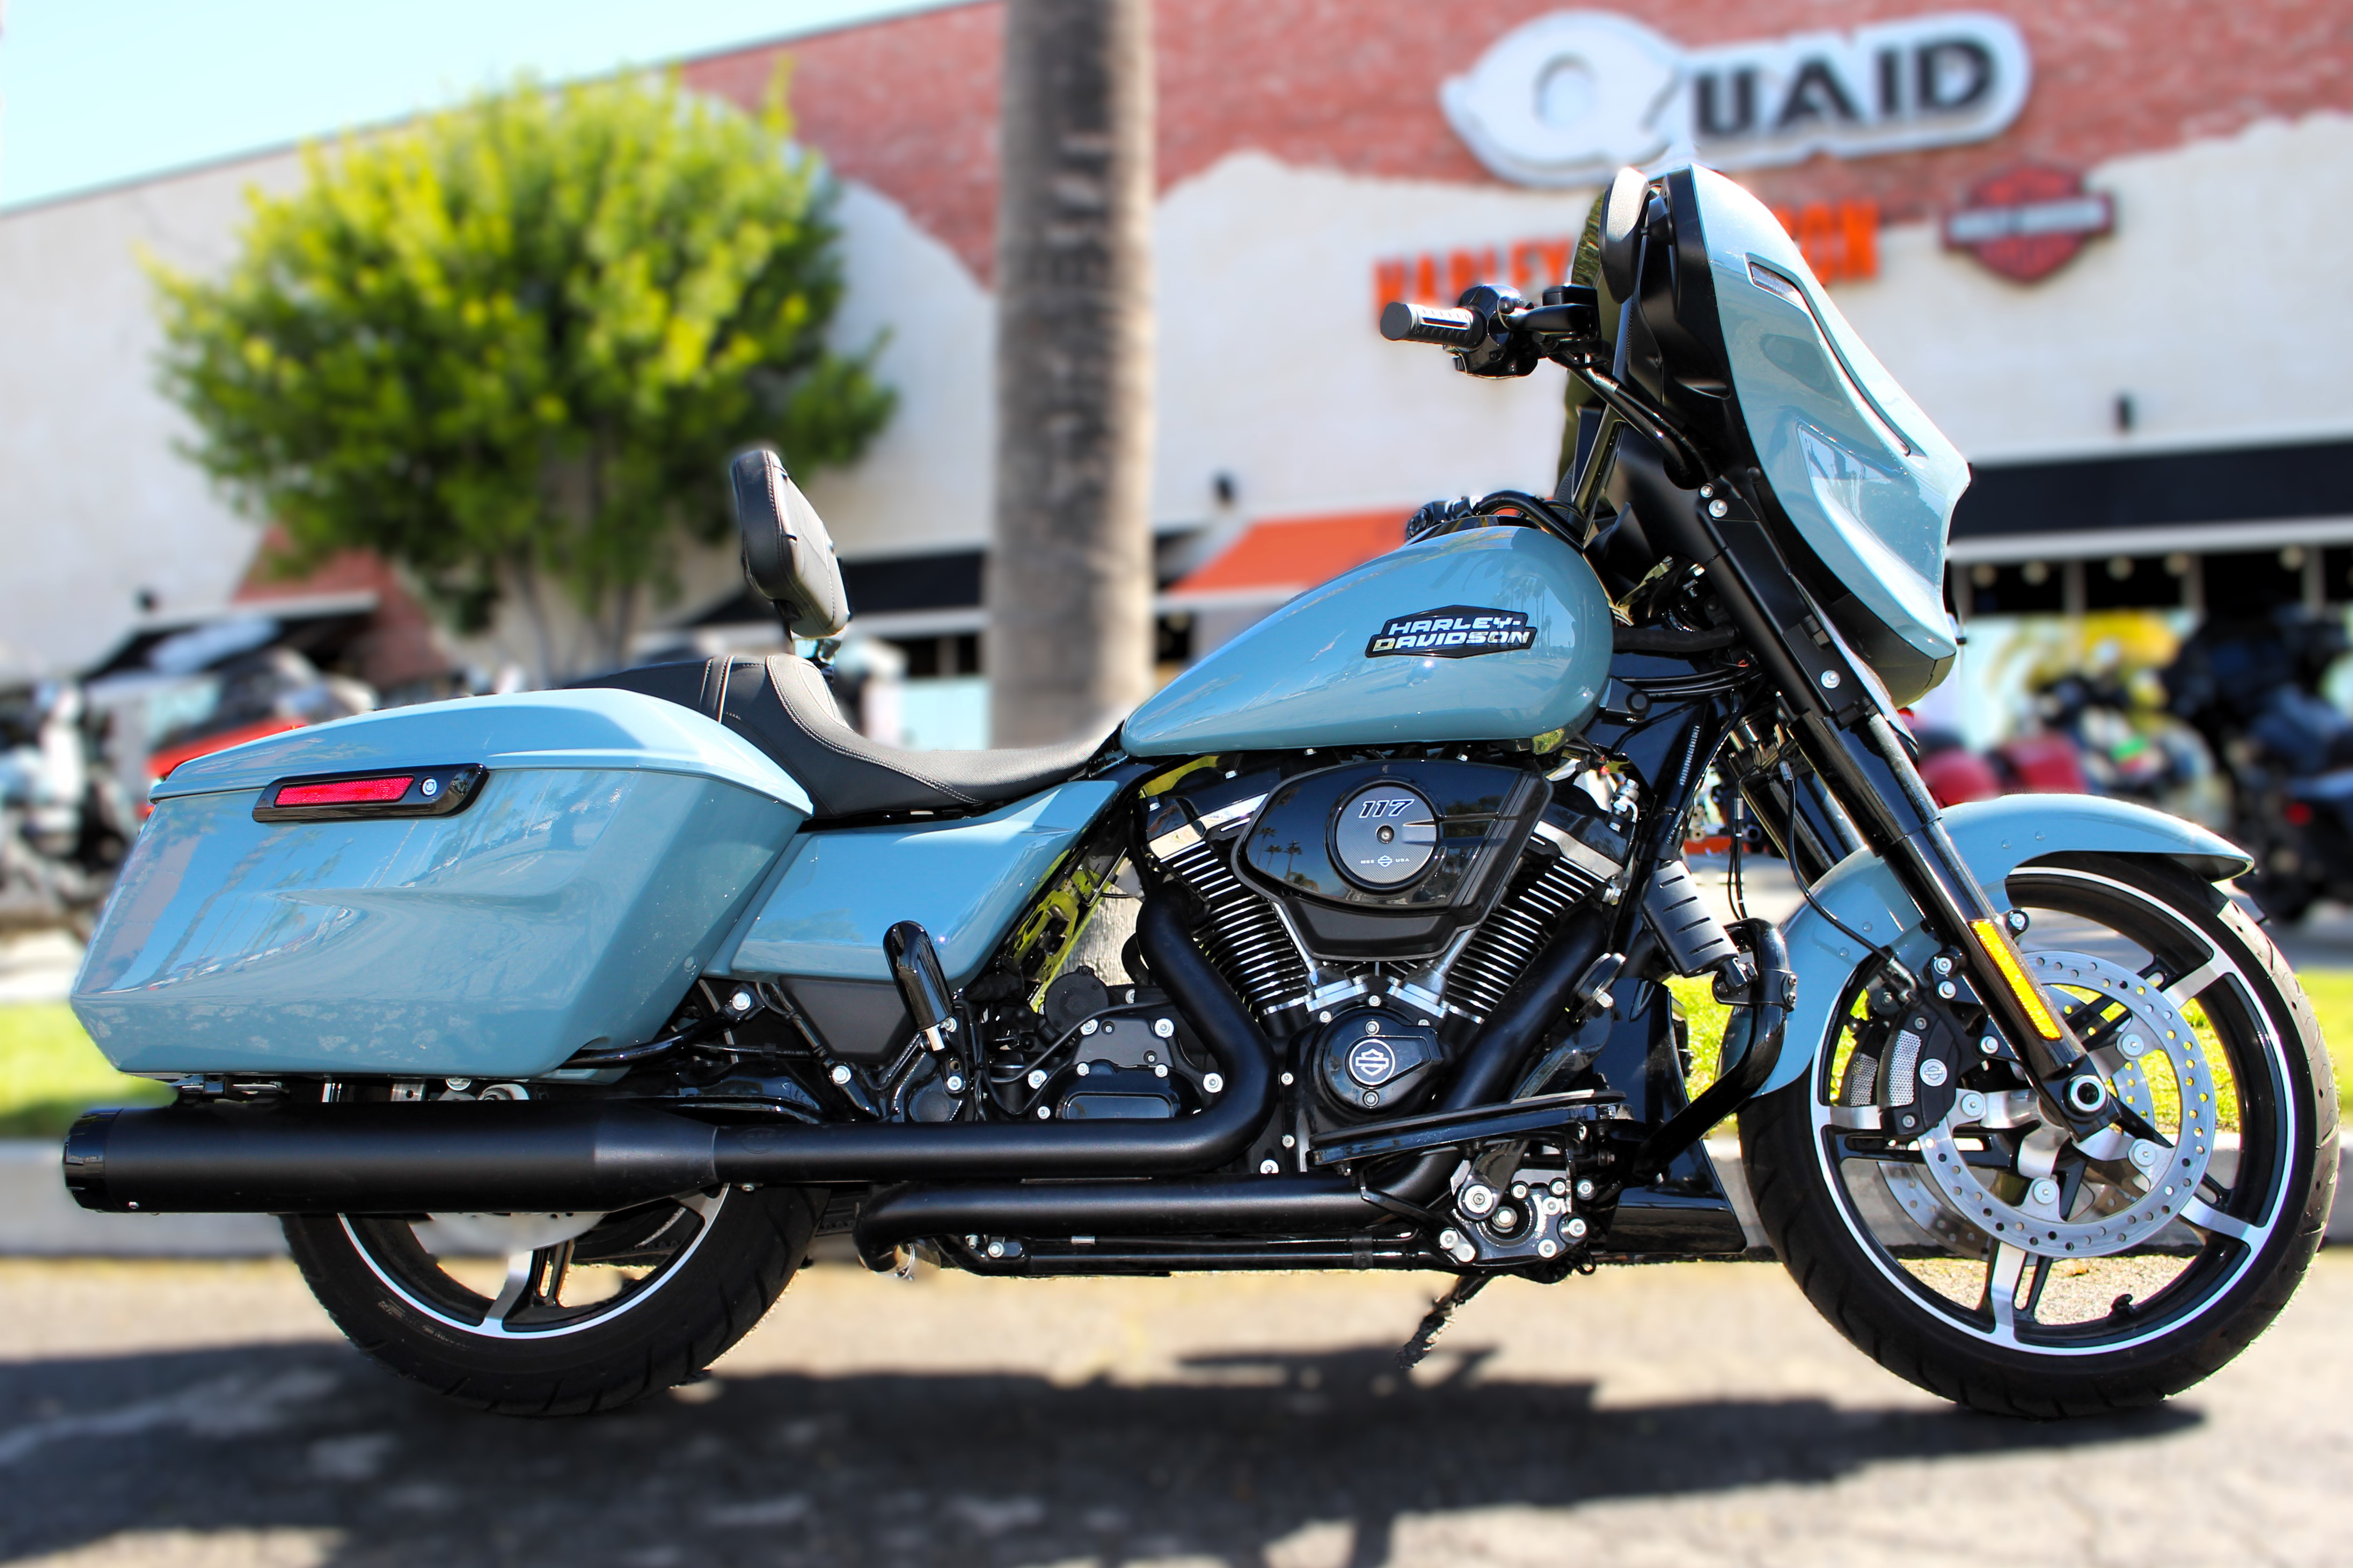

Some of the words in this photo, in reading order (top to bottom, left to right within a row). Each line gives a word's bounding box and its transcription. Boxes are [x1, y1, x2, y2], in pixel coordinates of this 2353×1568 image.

[1445, 10, 2003, 182] QUAID
[1388, 617, 1521, 635] HARLEY-
[1372, 631, 1530, 652] DAVIDSON
[1359, 799, 1415, 818] 117
